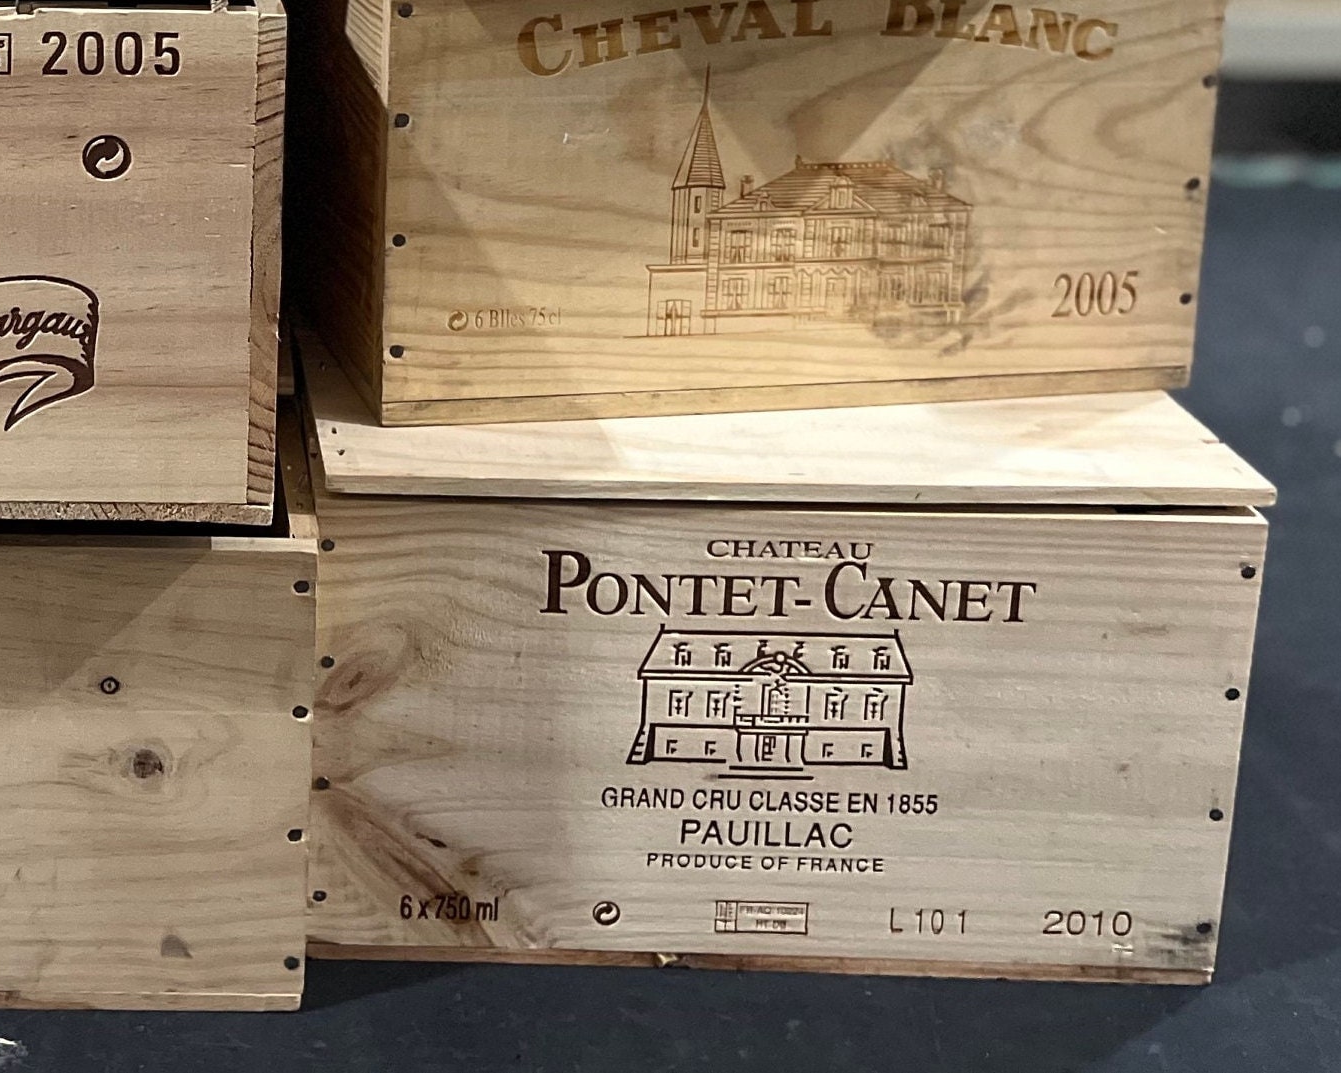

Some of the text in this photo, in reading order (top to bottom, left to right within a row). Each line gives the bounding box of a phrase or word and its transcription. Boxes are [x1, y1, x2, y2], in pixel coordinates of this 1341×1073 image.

[41, 31, 182, 77] 2005
[1051, 271, 1140, 318] 2005
[475, 309, 484, 329] 6
[529, 307, 546, 327] 75
[706, 539, 874, 560] CHATEAU
[601, 787, 938, 815] GRAND CRU CLASSE EN 1855
[679, 819, 853, 848] PAUILLAC
[646, 853, 884, 872] PRODUCE OF FRANCE
[400, 895, 412, 919] 6
[435, 895, 471, 919] 750
[476, 896, 499, 921] ml
[1042, 910, 1132, 936] 2010
